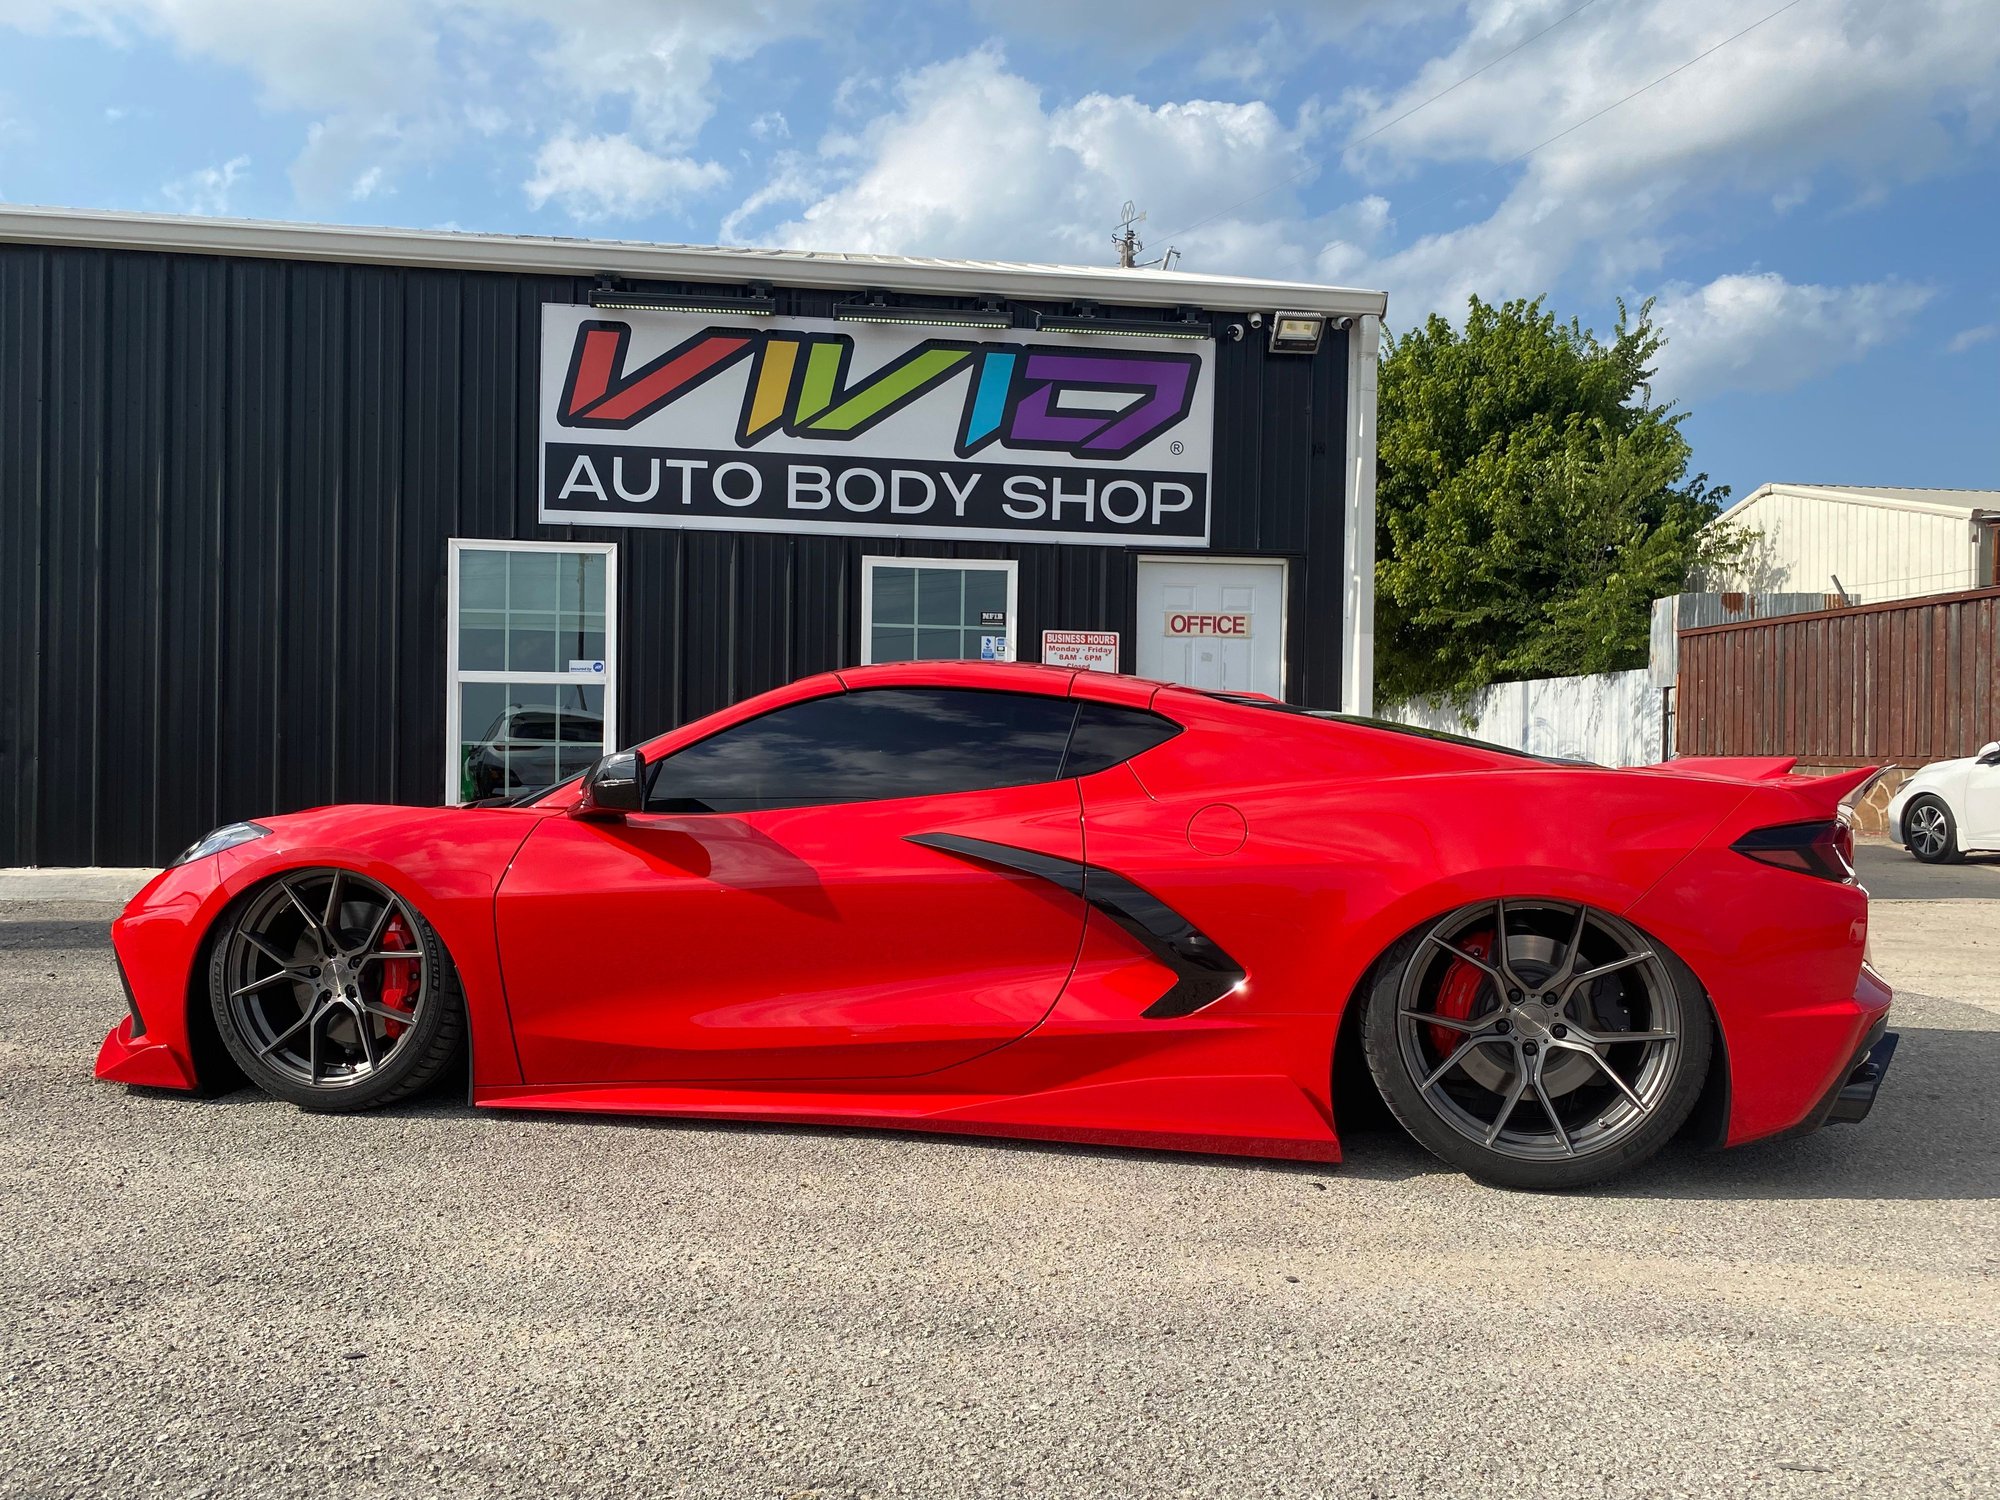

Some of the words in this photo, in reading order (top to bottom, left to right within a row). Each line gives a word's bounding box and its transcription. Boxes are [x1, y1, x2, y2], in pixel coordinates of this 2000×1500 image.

[557, 320, 1202, 461] VIVID
[558, 455, 763, 507] AUTO
[787, 465, 982, 517] BODY
[1001, 475, 1194, 526] SHOP
[1046, 633, 1086, 643] BUSINESS
[1087, 635, 1115, 644] HOURS
[1048, 645, 1081, 653] Monday
[1087, 646, 1113, 655] Friday
[1170, 614, 1245, 634] OFFICE
[425, 926, 440, 991] MICHELIN
[214, 962, 228, 1024] MICHELIN
